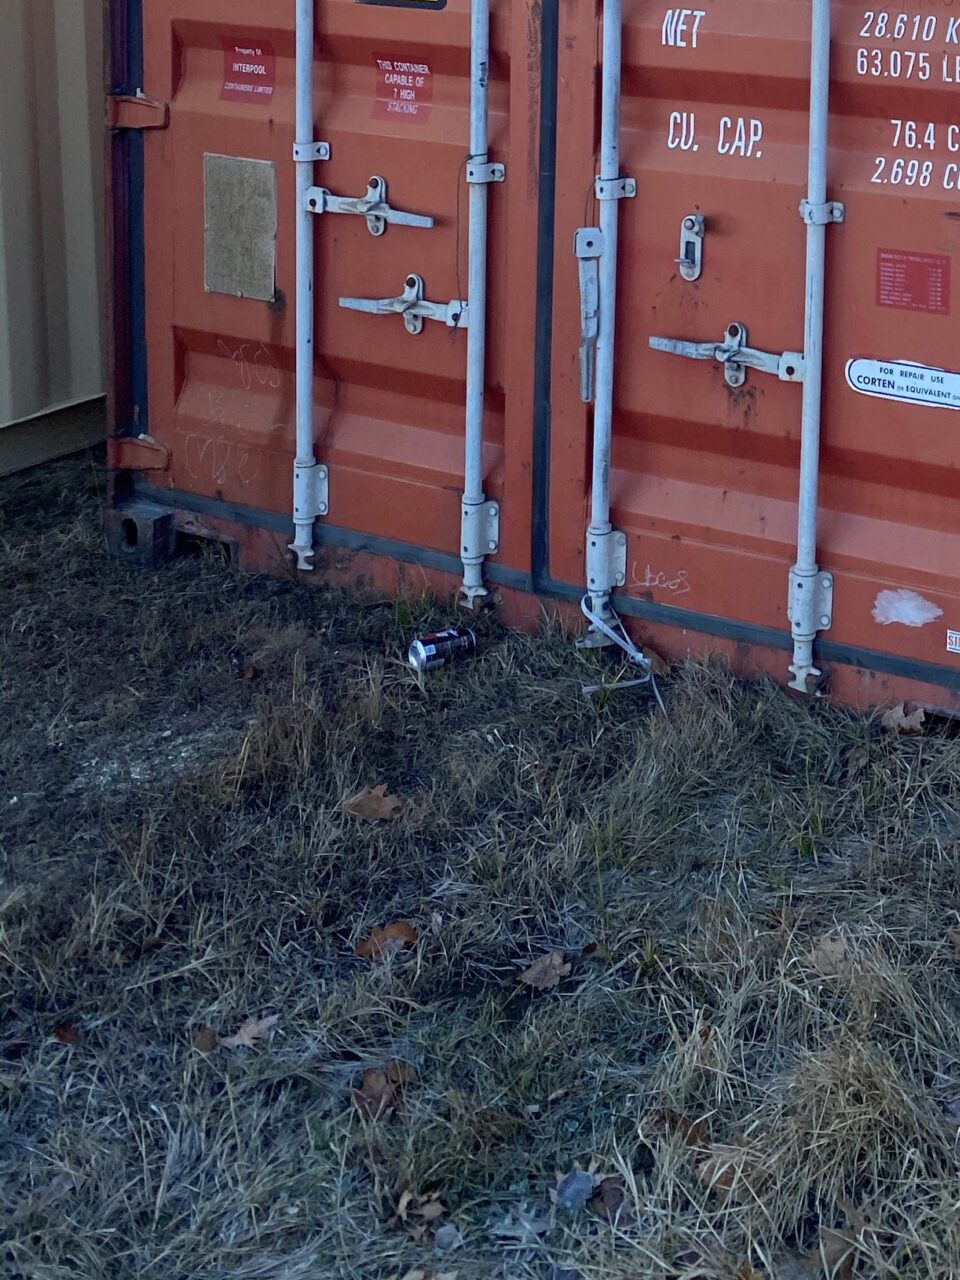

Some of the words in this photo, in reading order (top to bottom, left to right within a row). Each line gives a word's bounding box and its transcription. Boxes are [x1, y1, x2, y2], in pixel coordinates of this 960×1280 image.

[661, 8, 706, 49] NET
[232, 62, 267, 74] INTERPOOL
[377, 59, 393, 69] THIS
[393, 61, 430, 73] CONTAINER
[384, 73, 413, 86] CAPABLE
[415, 76, 425, 86] OF
[400, 89, 415, 100] HIGH
[387, 101, 418, 113] STACKING
[667, 111, 699, 152] CU.
[717, 116, 763, 158] CAP.
[890, 119, 936, 150] 76.4
[879, 366, 894, 375] FOR
[899, 370, 925, 380] REPAIR
[930, 374, 945, 383] USE
[856, 374, 896, 389] CORTEN
[905, 384, 952, 399] EQUIVALENT
